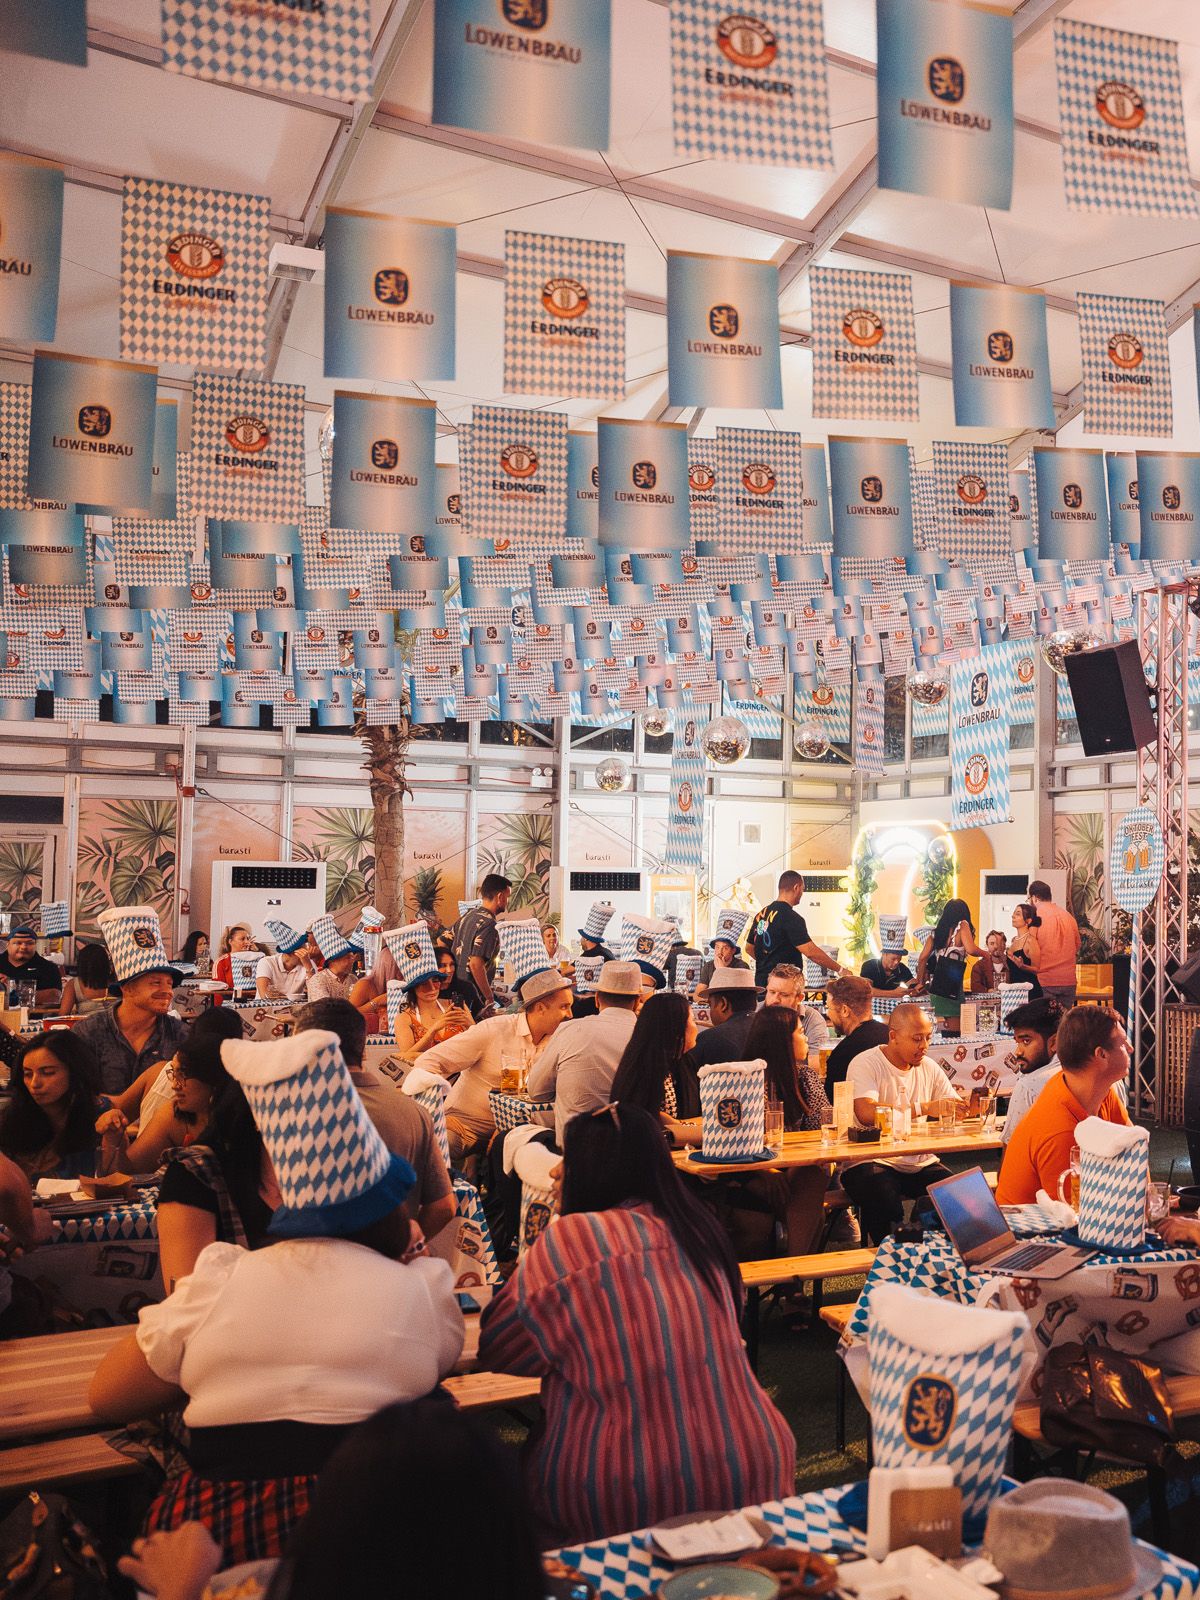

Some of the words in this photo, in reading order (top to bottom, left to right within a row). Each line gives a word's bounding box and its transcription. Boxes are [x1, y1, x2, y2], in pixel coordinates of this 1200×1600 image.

[704, 68, 794, 98] ERDINGER
[1087, 129, 1161, 155] ERDINGER
[153, 279, 238, 303] ERDINGER
[531, 320, 600, 340] ERDINGER
[834, 350, 895, 366] ERDINGER
[1102, 371, 1152, 386] ERDINGER
[215, 453, 278, 471] ERDINGER
[492, 479, 547, 494] ERDINGER
[736, 496, 784, 509] ERDINGER
[952, 506, 995, 518] ERDINGER
[806, 706, 839, 717] ERDINGER
[959, 797, 995, 813] ERDINGER
[674, 815, 696, 825] ERDINGER
[1124, 823, 1154, 836] OKTOBER
[1131, 832, 1148, 841] FEST
[219, 845, 251, 854] barasti
[413, 851, 442, 860] barasti
